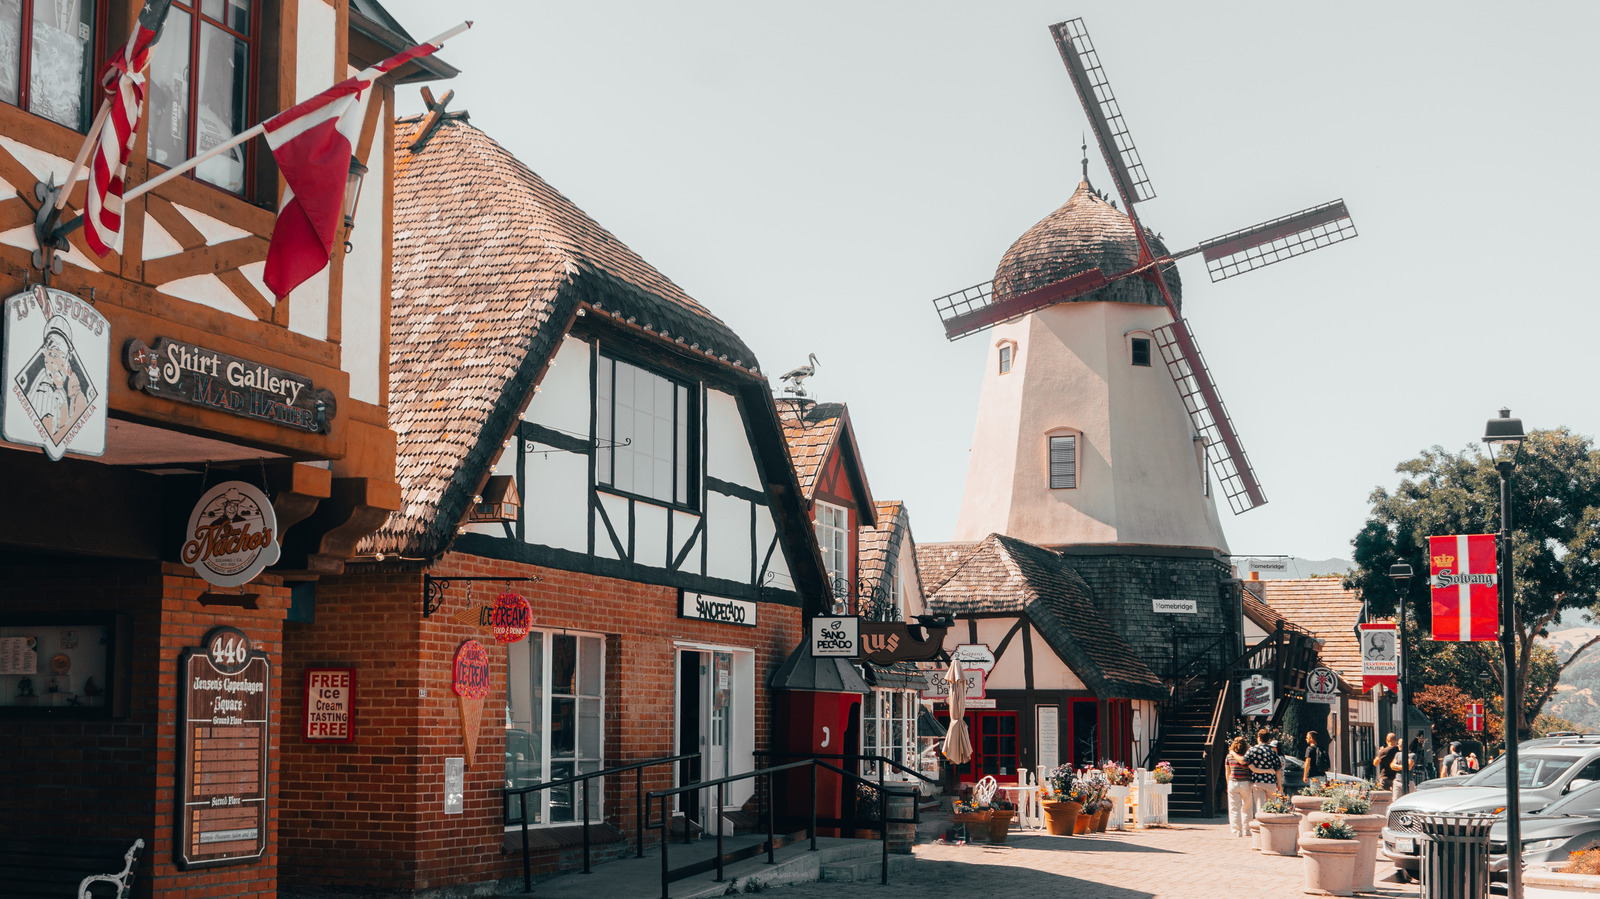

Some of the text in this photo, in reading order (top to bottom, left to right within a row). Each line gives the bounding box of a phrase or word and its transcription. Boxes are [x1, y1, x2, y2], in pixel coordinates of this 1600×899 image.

[54, 295, 105, 337] SPORTS
[163, 343, 305, 406] Shirt Gallery
[63, 404, 97, 448] MEMORABILIA
[183, 520, 272, 564] Nacho's
[1435, 569, 1494, 588] Solvang
[1155, 602, 1194, 610] Homebridge
[480, 605, 527, 628] ICE CREAM
[821, 628, 846, 640] SANO
[212, 637, 246, 663] 446
[817, 639, 853, 649] PECADO
[311, 675, 349, 688] FREE
[468, 663, 490, 688] CREAM
[193, 676, 263, 695] Jensen's Copenhagen
[319, 689, 340, 699] Ice
[213, 696, 242, 714] Square
[316, 700, 342, 710] Cream
[310, 712, 347, 721] TASTING
[310, 722, 347, 736] FREE
